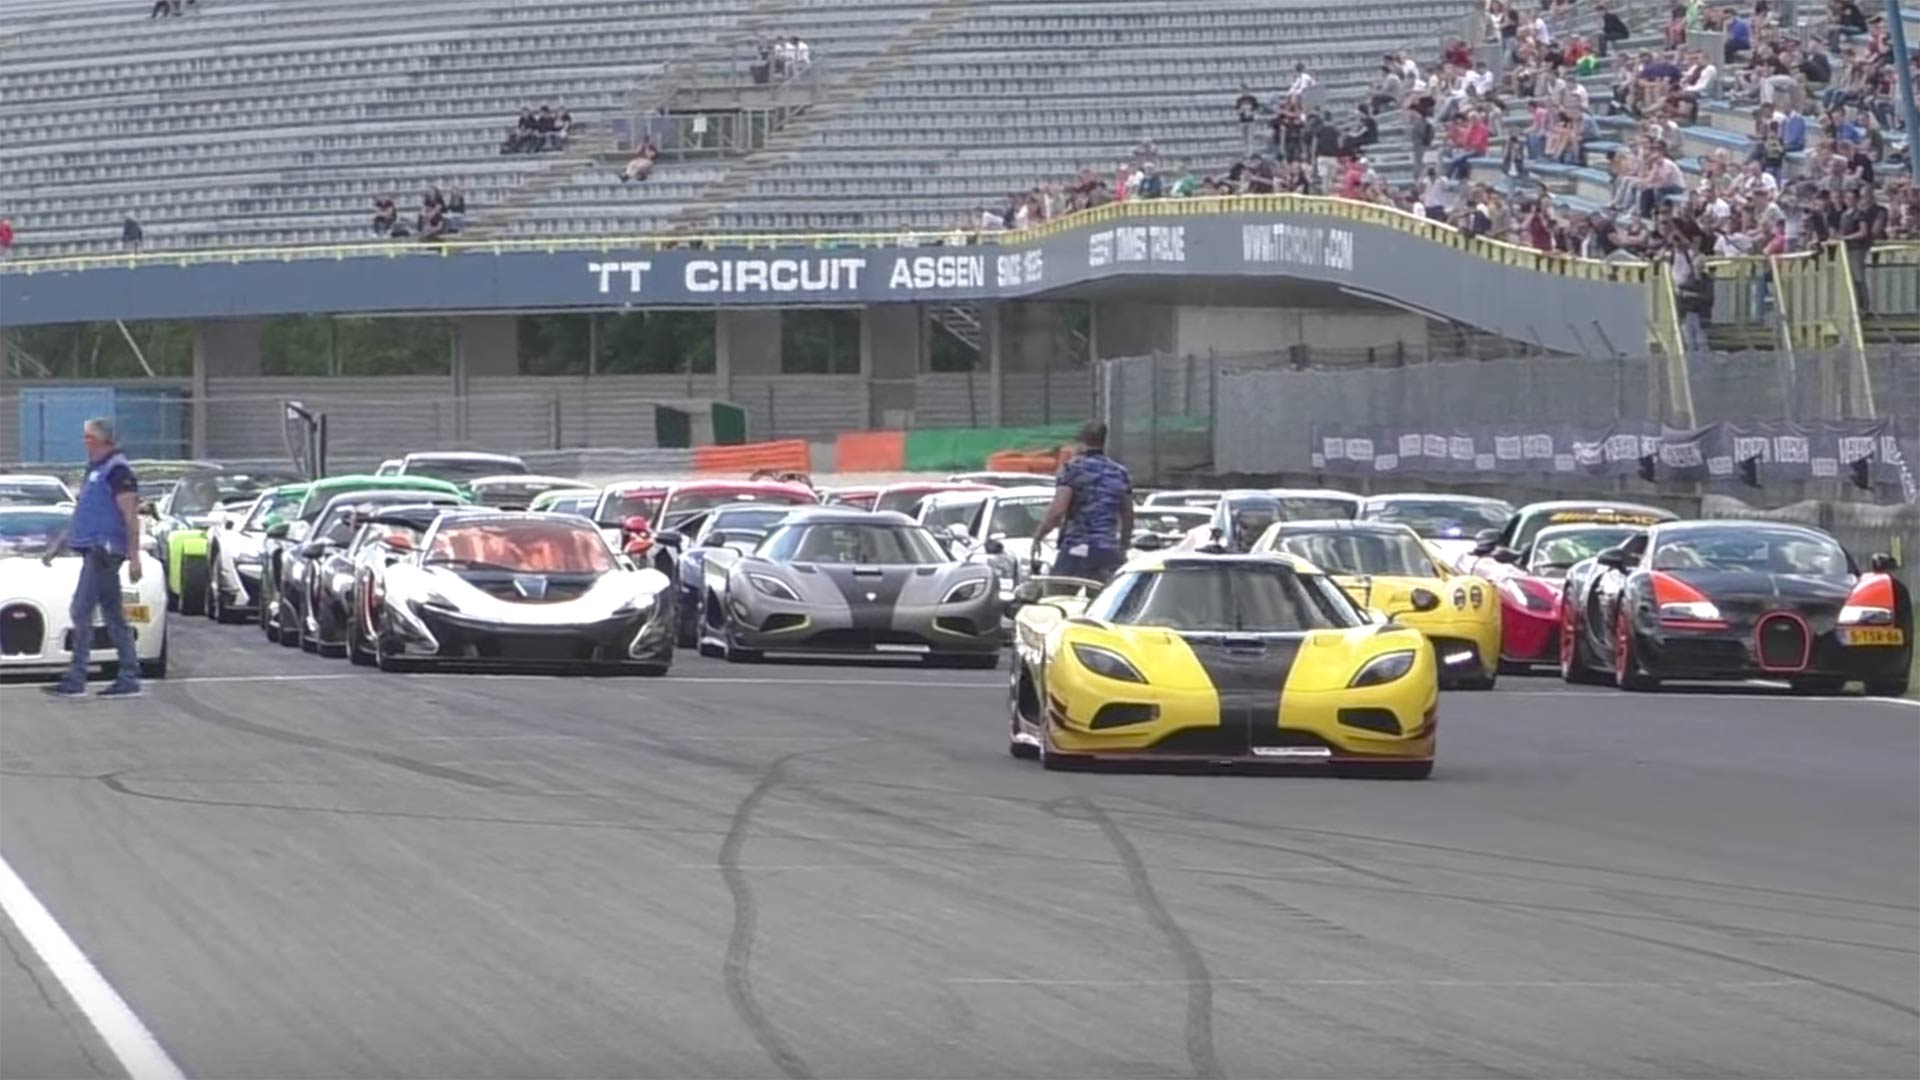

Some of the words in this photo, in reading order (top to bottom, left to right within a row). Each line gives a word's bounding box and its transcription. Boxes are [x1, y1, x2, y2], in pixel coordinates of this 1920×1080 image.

[588, 261, 652, 292] TT
[685, 258, 866, 292] CIRCUIT
[889, 255, 984, 289] ASSEN
